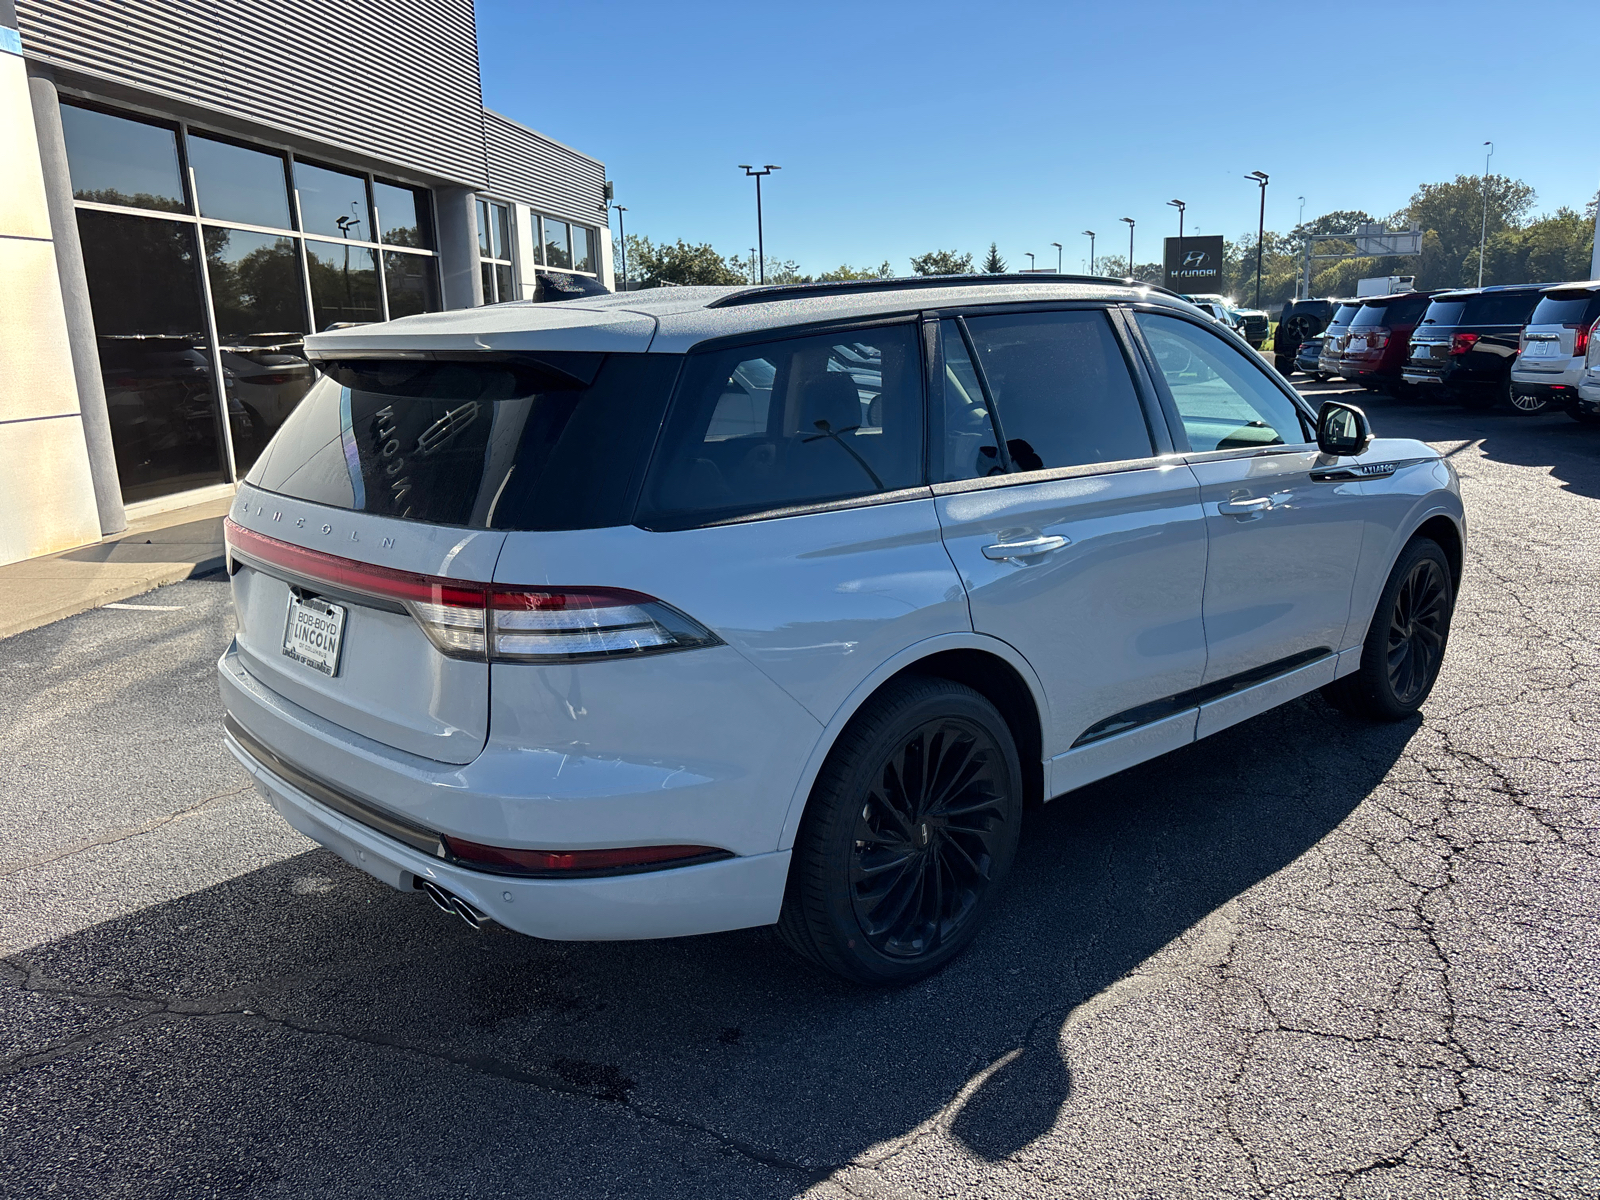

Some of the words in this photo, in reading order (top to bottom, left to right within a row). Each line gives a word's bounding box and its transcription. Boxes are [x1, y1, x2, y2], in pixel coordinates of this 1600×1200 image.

[1171, 269, 1216, 278] HYUNDAI
[242, 502, 396, 549] LINCOLN
[294, 623, 336, 653] LINCOLN
[282, 648, 300, 662] LINCOLN
[306, 658, 332, 676] COLUMBUS
